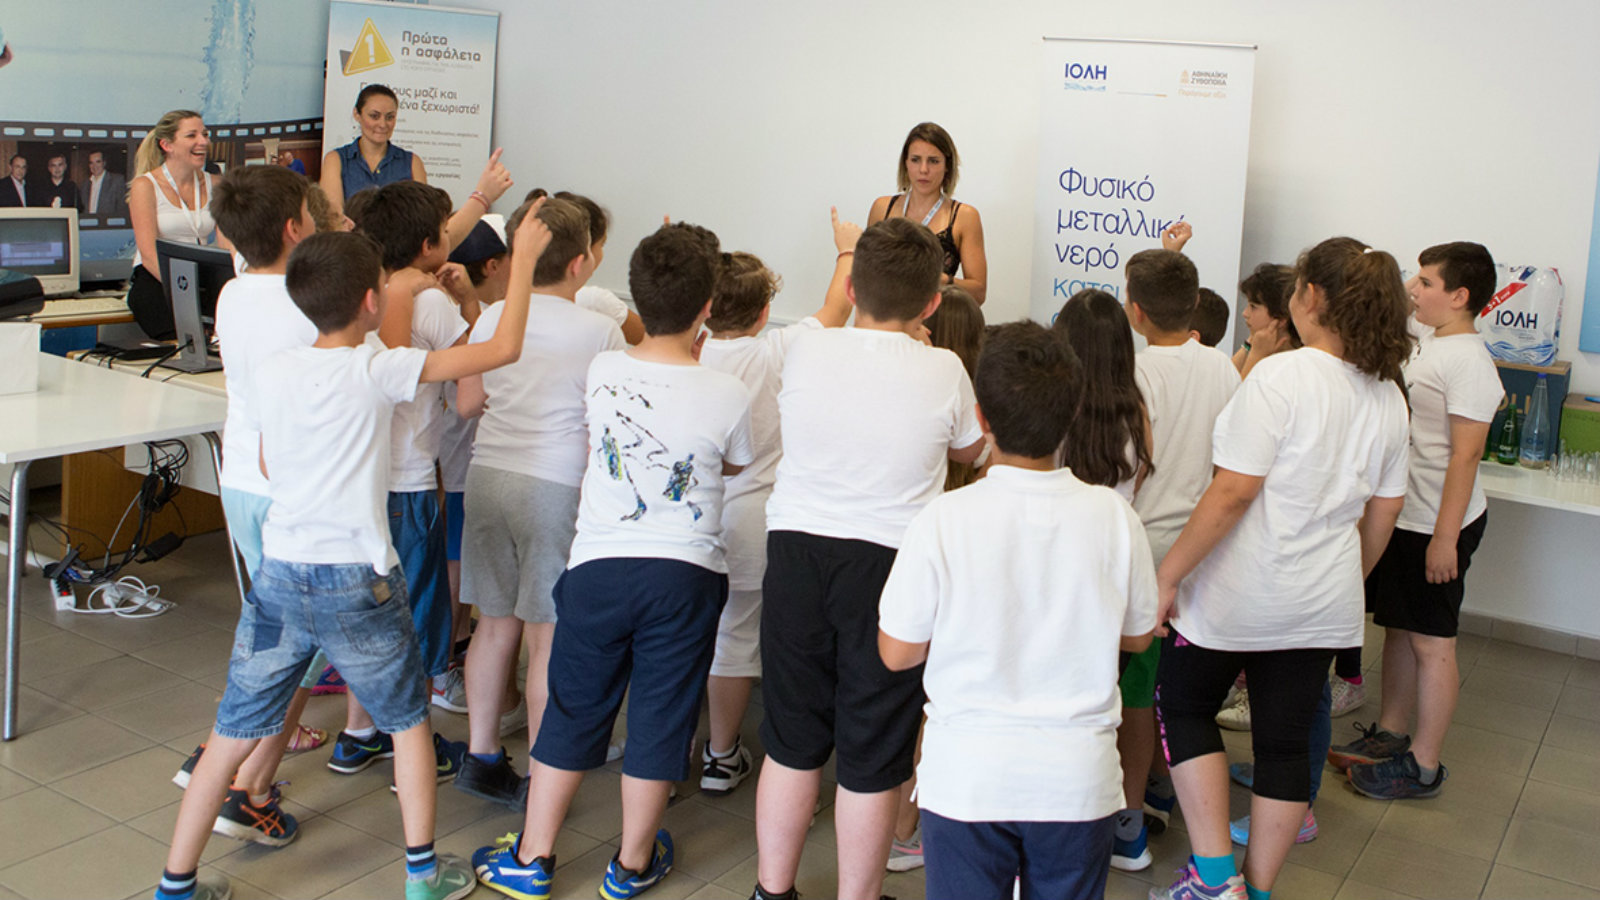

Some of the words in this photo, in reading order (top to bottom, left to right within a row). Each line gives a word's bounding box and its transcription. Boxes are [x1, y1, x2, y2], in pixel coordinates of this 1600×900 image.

[402, 30, 448, 46] Πρώτα
[416, 47, 481, 62] ασφάλεια
[1065, 63, 1107, 80] ΙΟΛΗ
[414, 87, 438, 99] μαζί
[440, 91, 457, 100] και
[421, 101, 480, 115] ξεχωριστά!
[1059, 167, 1154, 202] Φυσικό
[1057, 208, 1184, 239] μεταλλικ
[1055, 243, 1119, 272] νερό
[1496, 310, 1538, 329] ΙΟΛΗ
